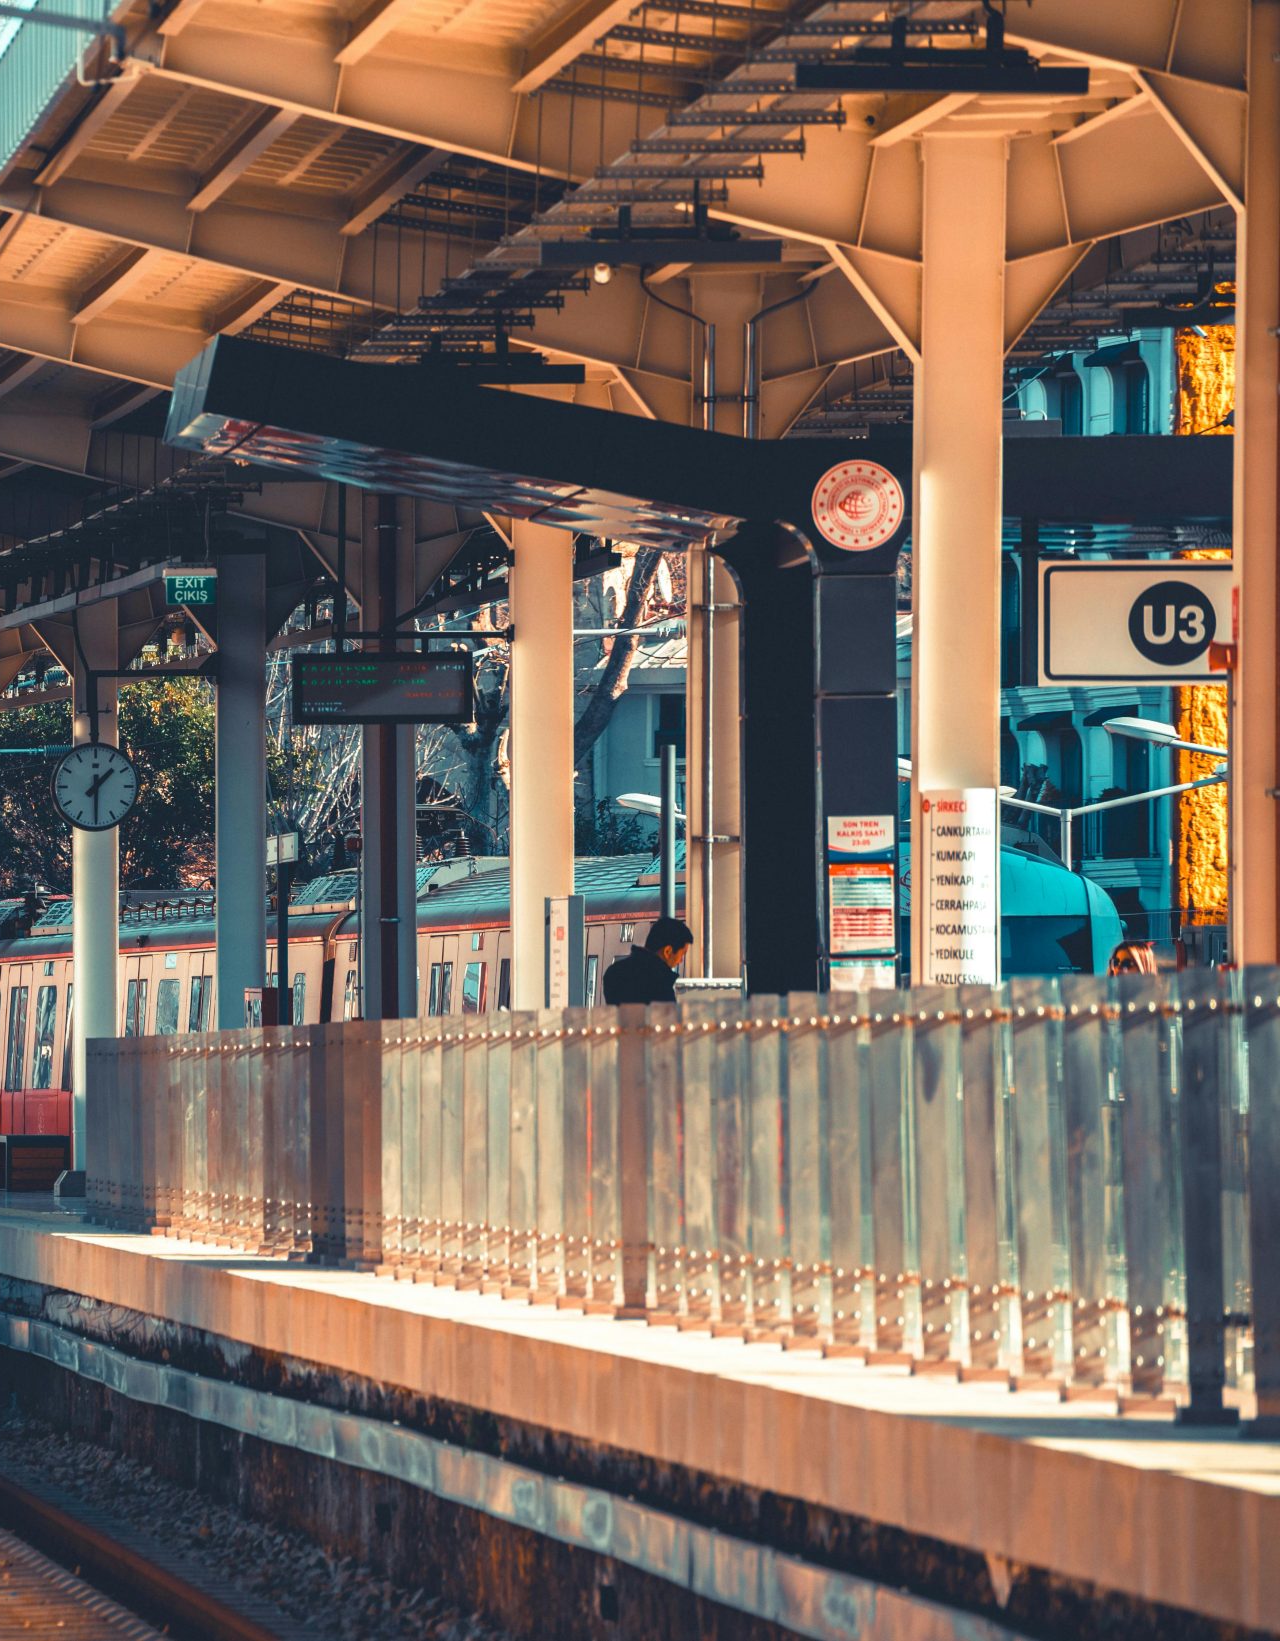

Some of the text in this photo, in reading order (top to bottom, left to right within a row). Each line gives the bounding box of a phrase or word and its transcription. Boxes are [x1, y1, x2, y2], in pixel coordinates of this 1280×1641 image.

[175, 578, 207, 588] EXIT
[174, 590, 208, 603] ÇIKIŞ
[1143, 605, 1206, 645] U3
[860, 820, 879, 828] TREN
[936, 850, 976, 862] KUMKAPI
[936, 872, 974, 886] YENİKAPI
[935, 946, 974, 960] YEDİKULE
